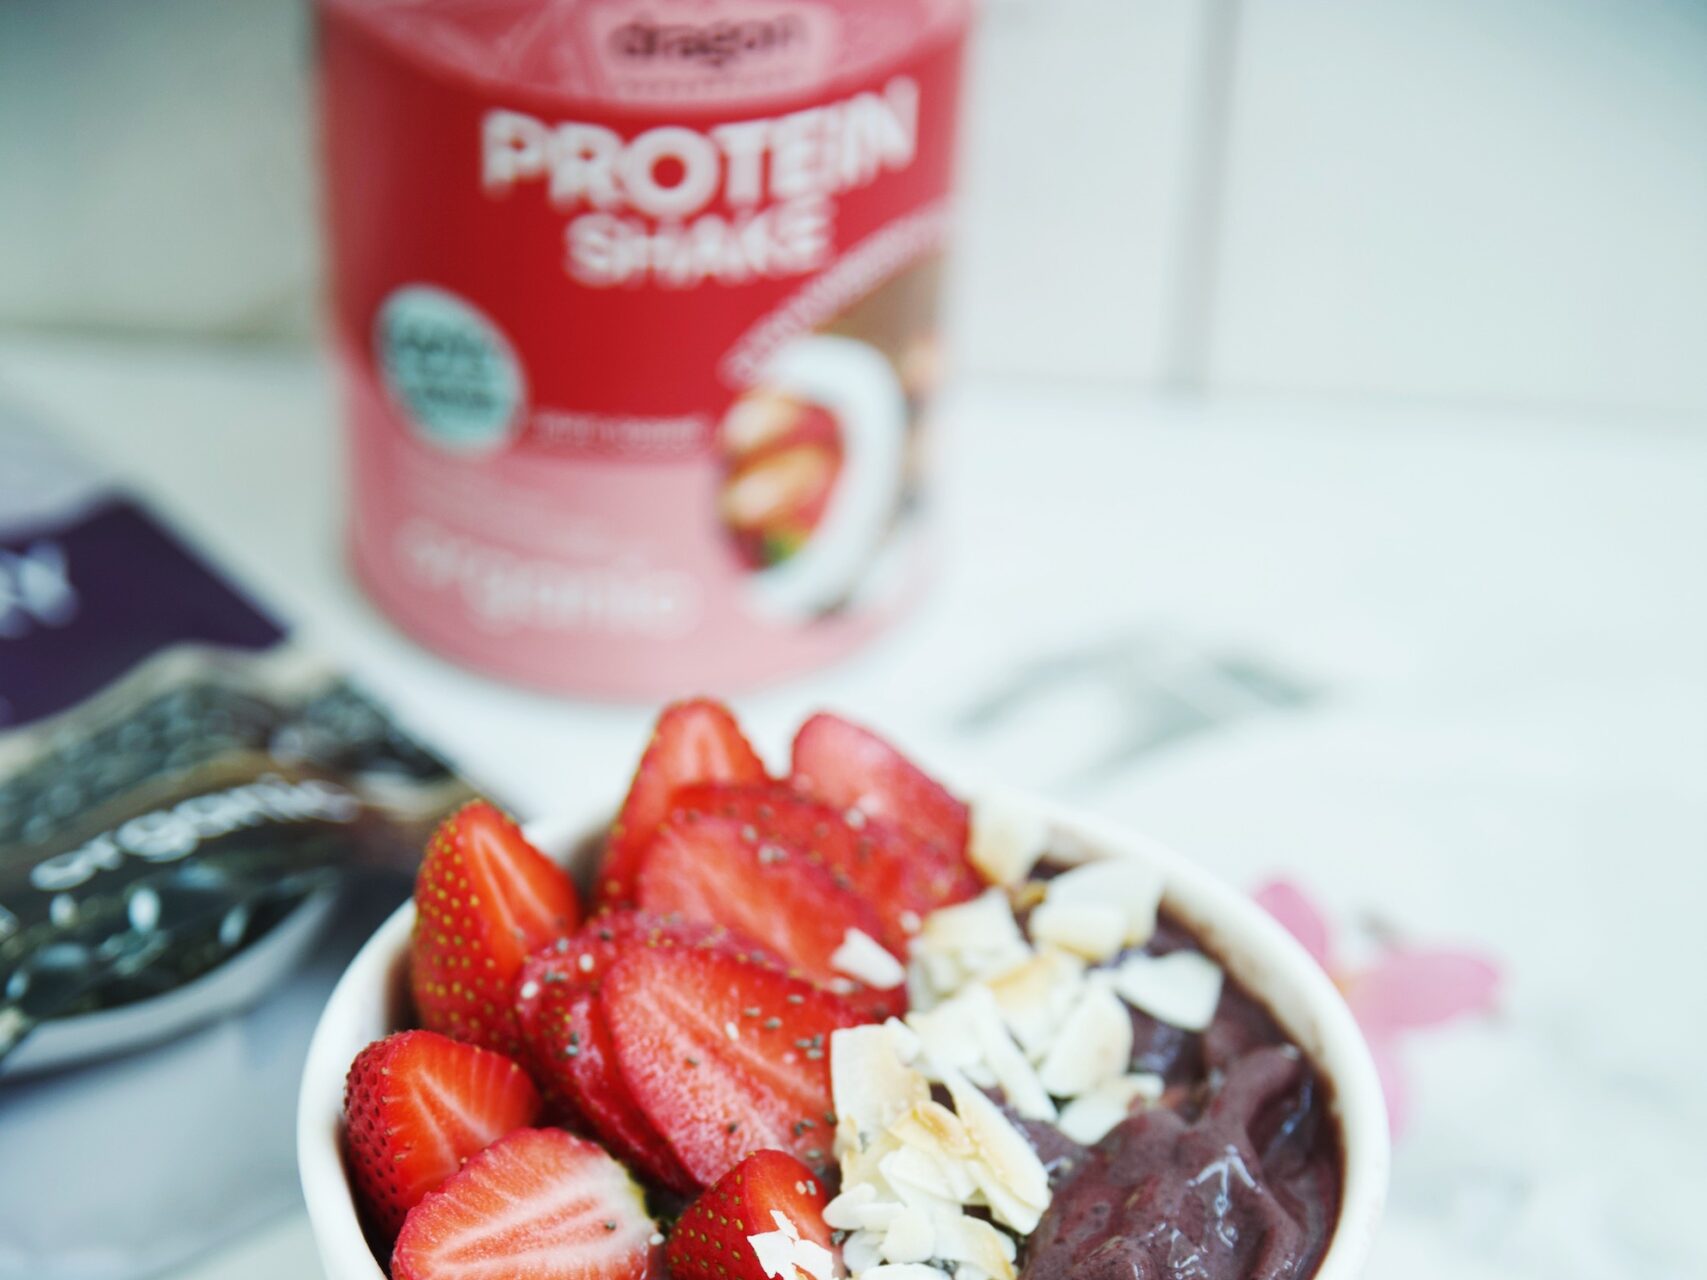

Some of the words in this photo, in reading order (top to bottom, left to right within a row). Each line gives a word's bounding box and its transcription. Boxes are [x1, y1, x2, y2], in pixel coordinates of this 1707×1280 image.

[611, 16, 805, 67] dragon
[482, 78, 920, 220] PROTEIN
[567, 195, 834, 285] SHAKE
